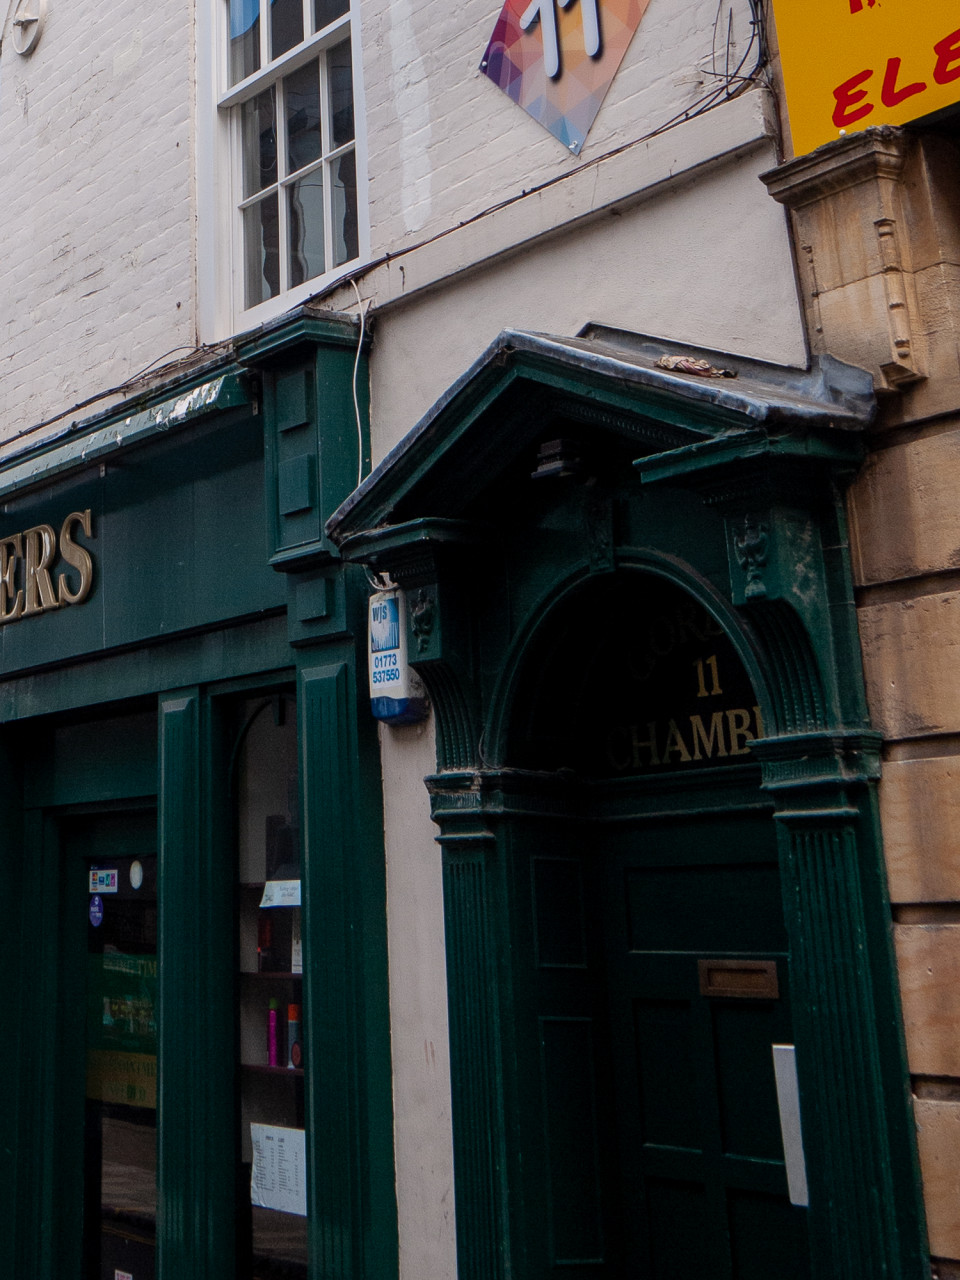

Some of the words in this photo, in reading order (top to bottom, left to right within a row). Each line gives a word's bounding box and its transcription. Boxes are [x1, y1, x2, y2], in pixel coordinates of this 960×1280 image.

[372, 602, 388, 624] wjs
[374, 653, 398, 668] 01773
[372, 669, 400, 684] 537550
[693, 654, 723, 697] 11
